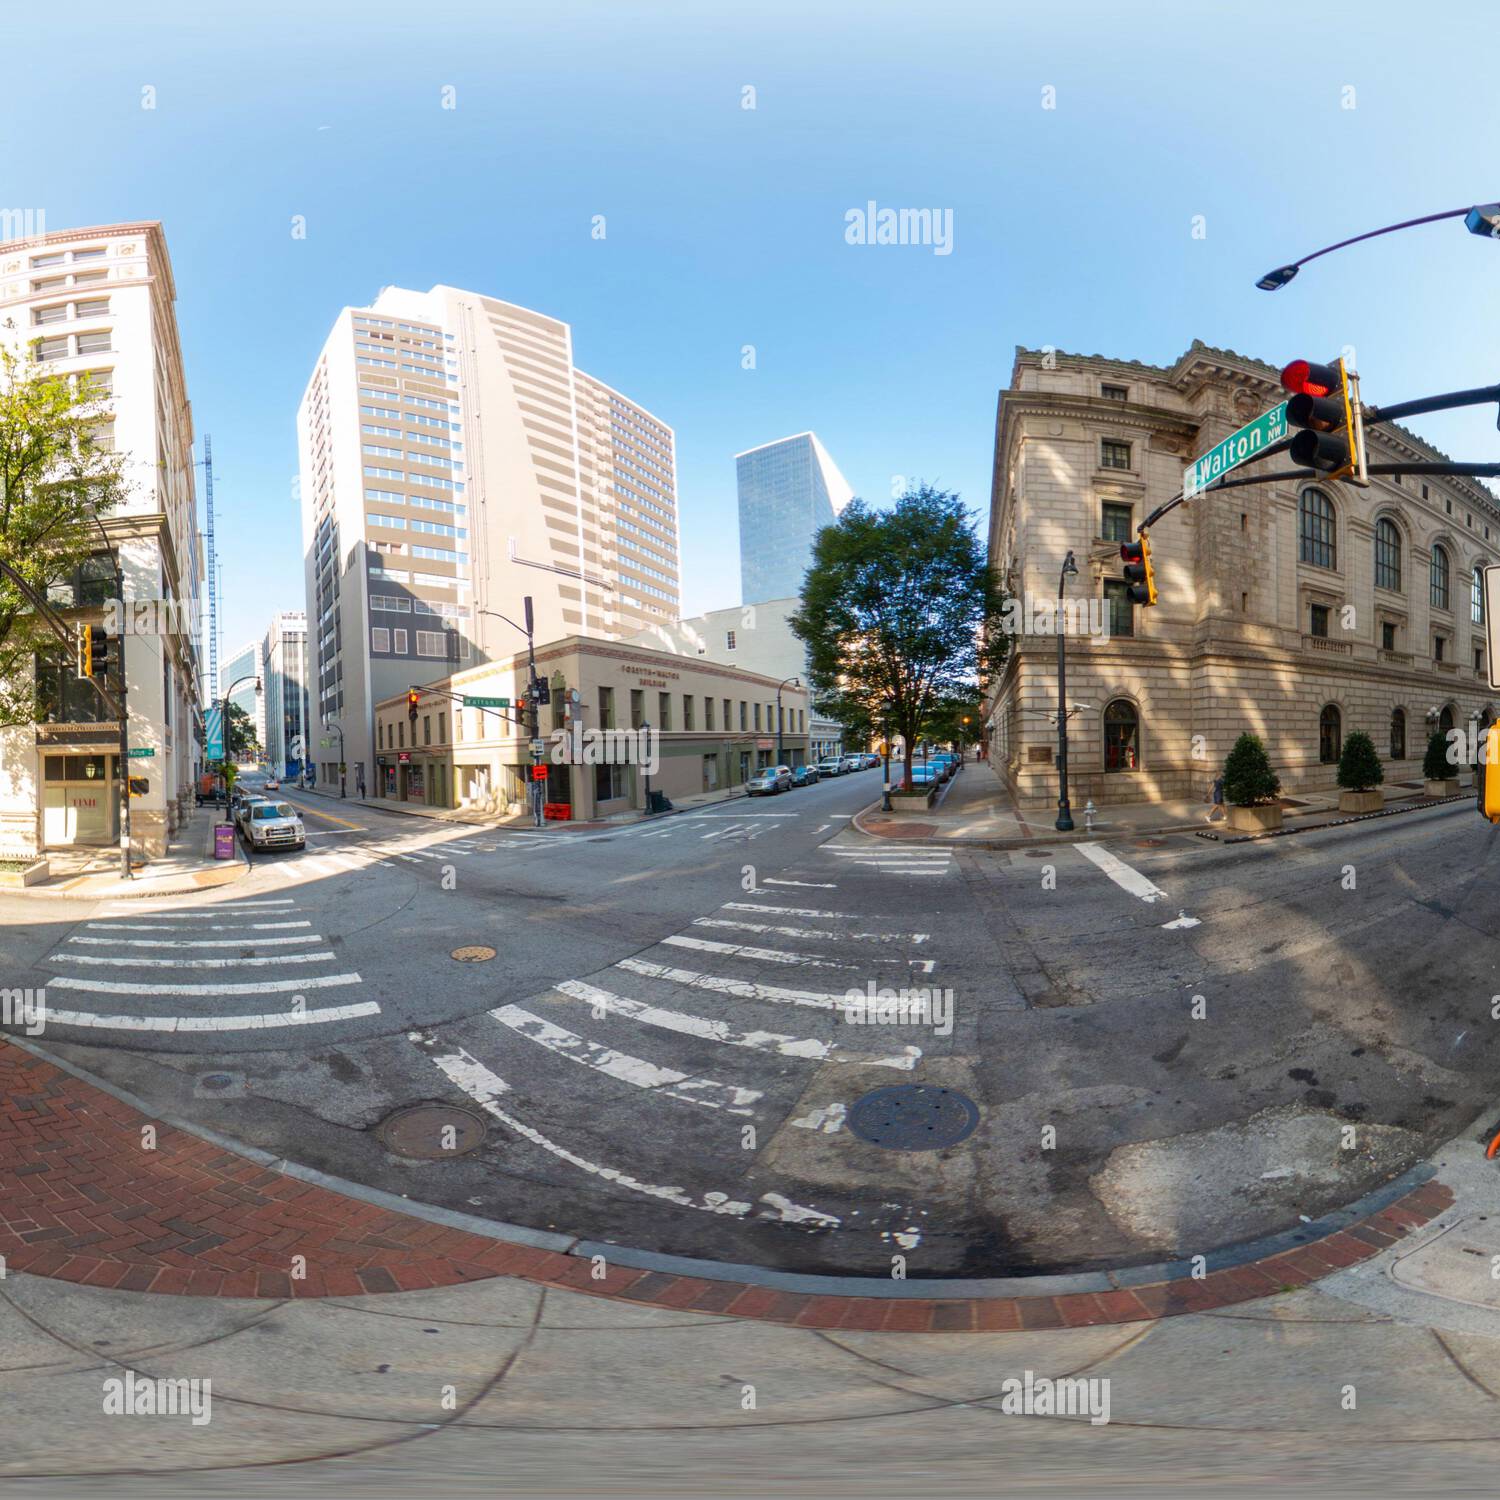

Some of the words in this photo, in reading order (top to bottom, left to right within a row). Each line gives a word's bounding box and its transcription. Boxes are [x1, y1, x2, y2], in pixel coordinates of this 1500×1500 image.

[1200, 428, 1261, 482] Walton
[1269, 408, 1282, 426] ST
[1267, 424, 1282, 441] NW
